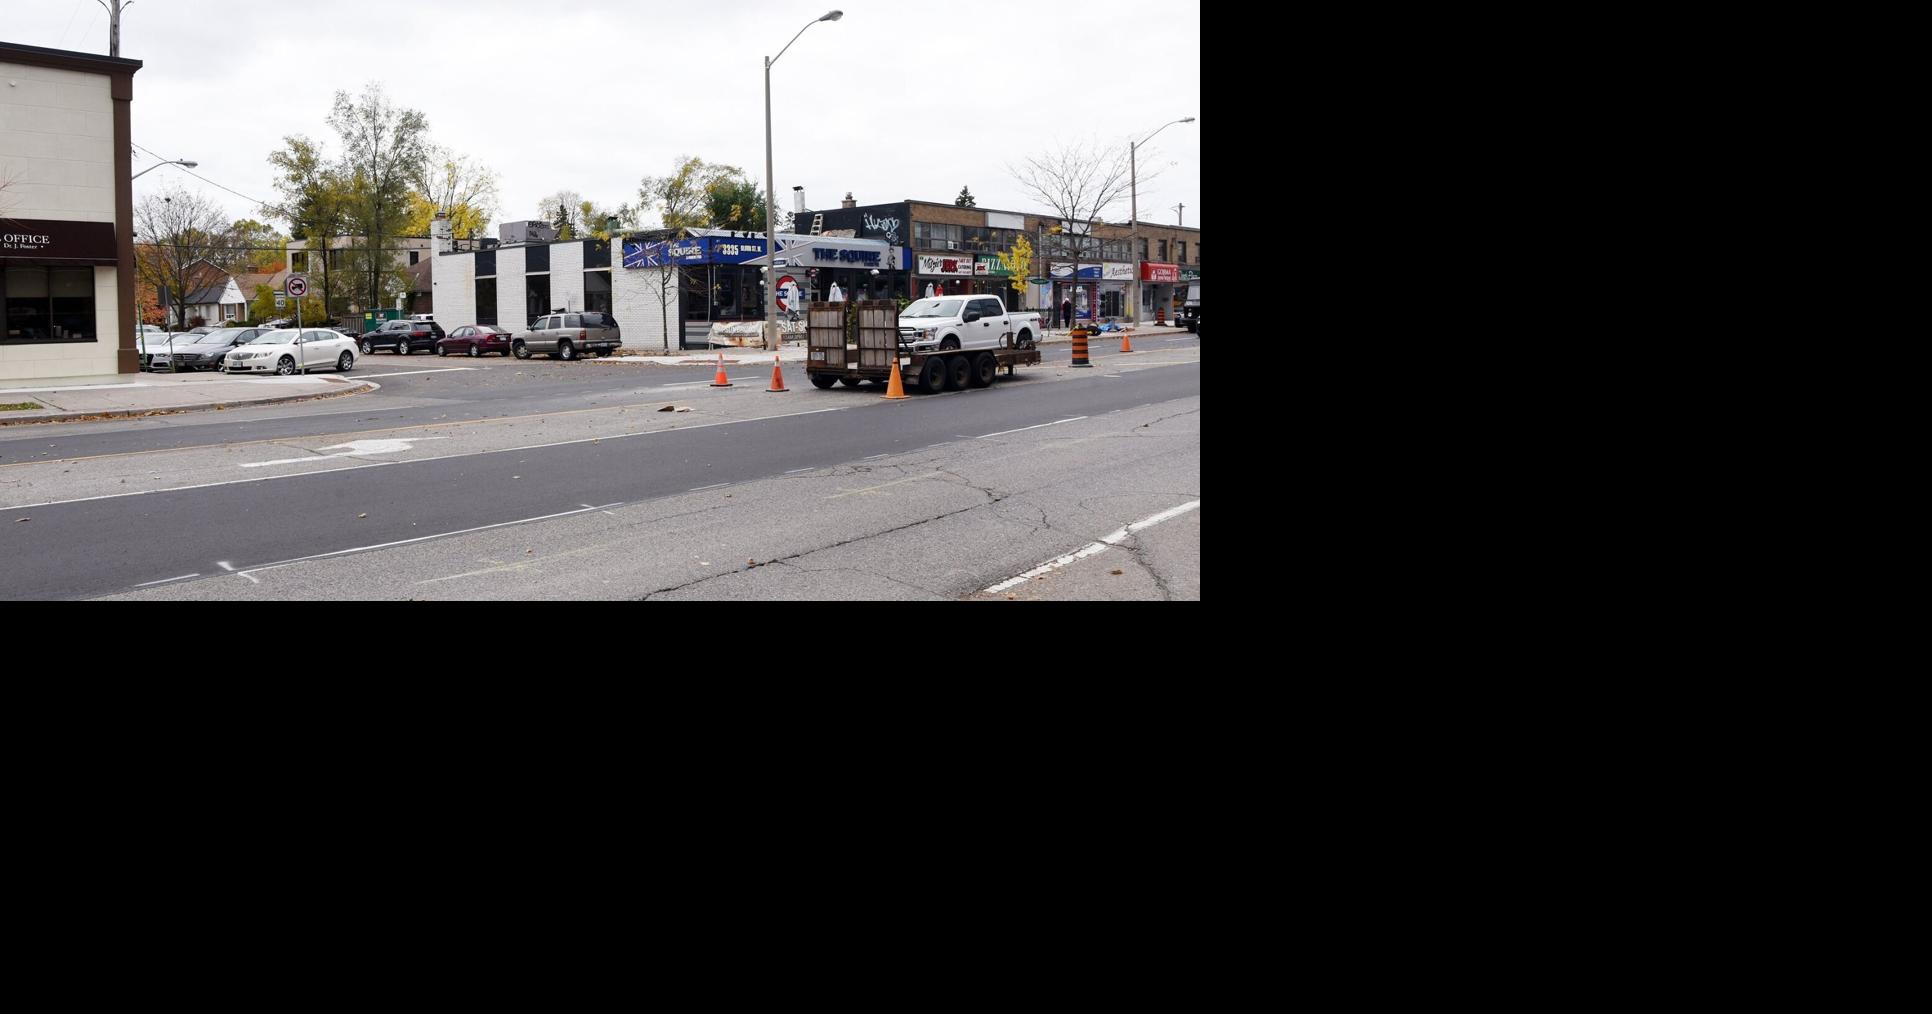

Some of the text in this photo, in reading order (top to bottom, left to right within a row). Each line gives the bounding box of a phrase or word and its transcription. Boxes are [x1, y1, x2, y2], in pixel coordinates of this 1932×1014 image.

[4, 234, 50, 244] OFFICE
[668, 247, 702, 257] SQUIRE
[722, 244, 739, 256] 3335
[812, 247, 881, 263] THE SQUIRE
